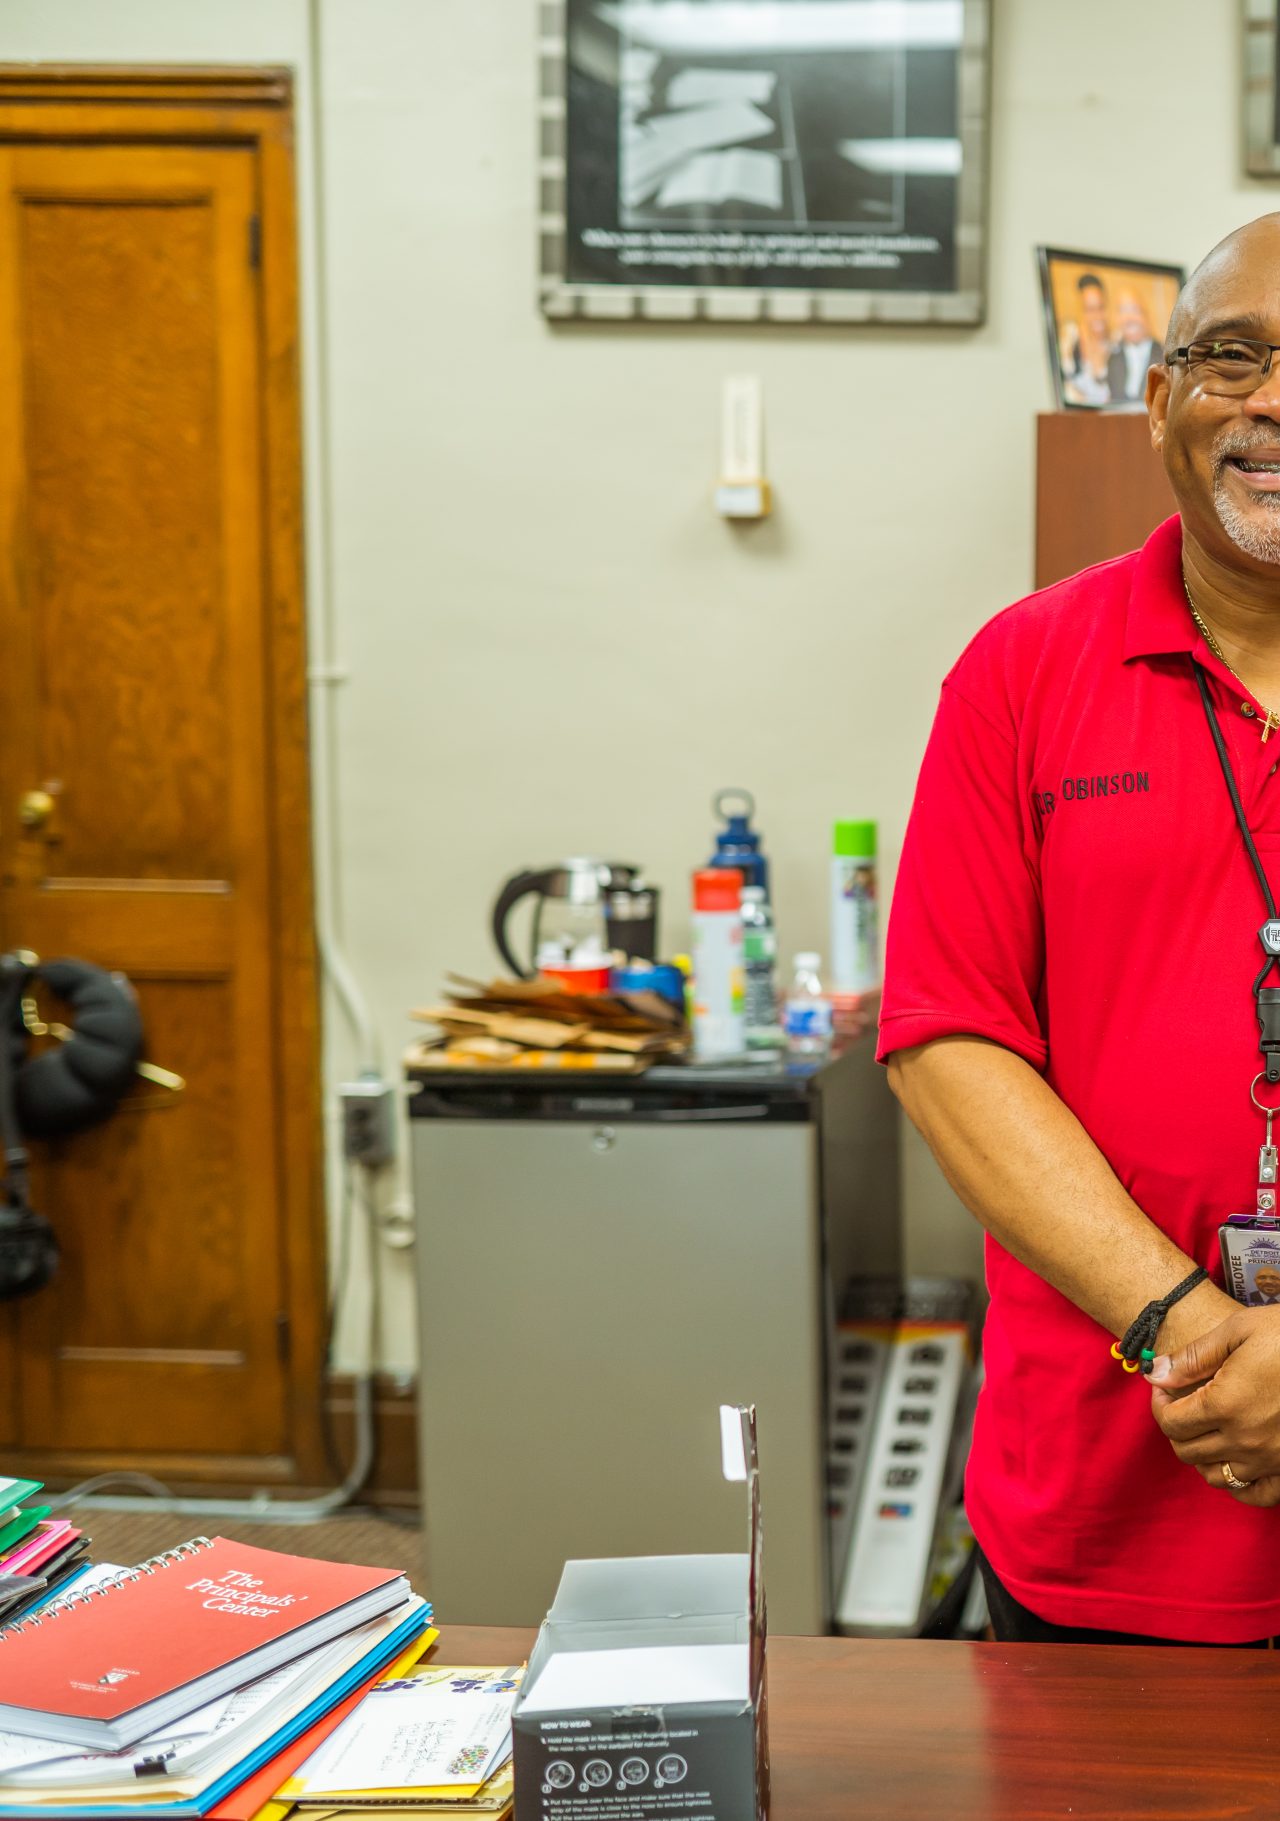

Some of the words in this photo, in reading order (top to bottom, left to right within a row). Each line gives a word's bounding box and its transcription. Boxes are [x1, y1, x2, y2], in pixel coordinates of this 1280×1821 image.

[1062, 771, 1150, 800] OBINSON
[218, 1570, 264, 1588] The
[185, 1578, 310, 1607] Principals'
[202, 1597, 280, 1618] Center
